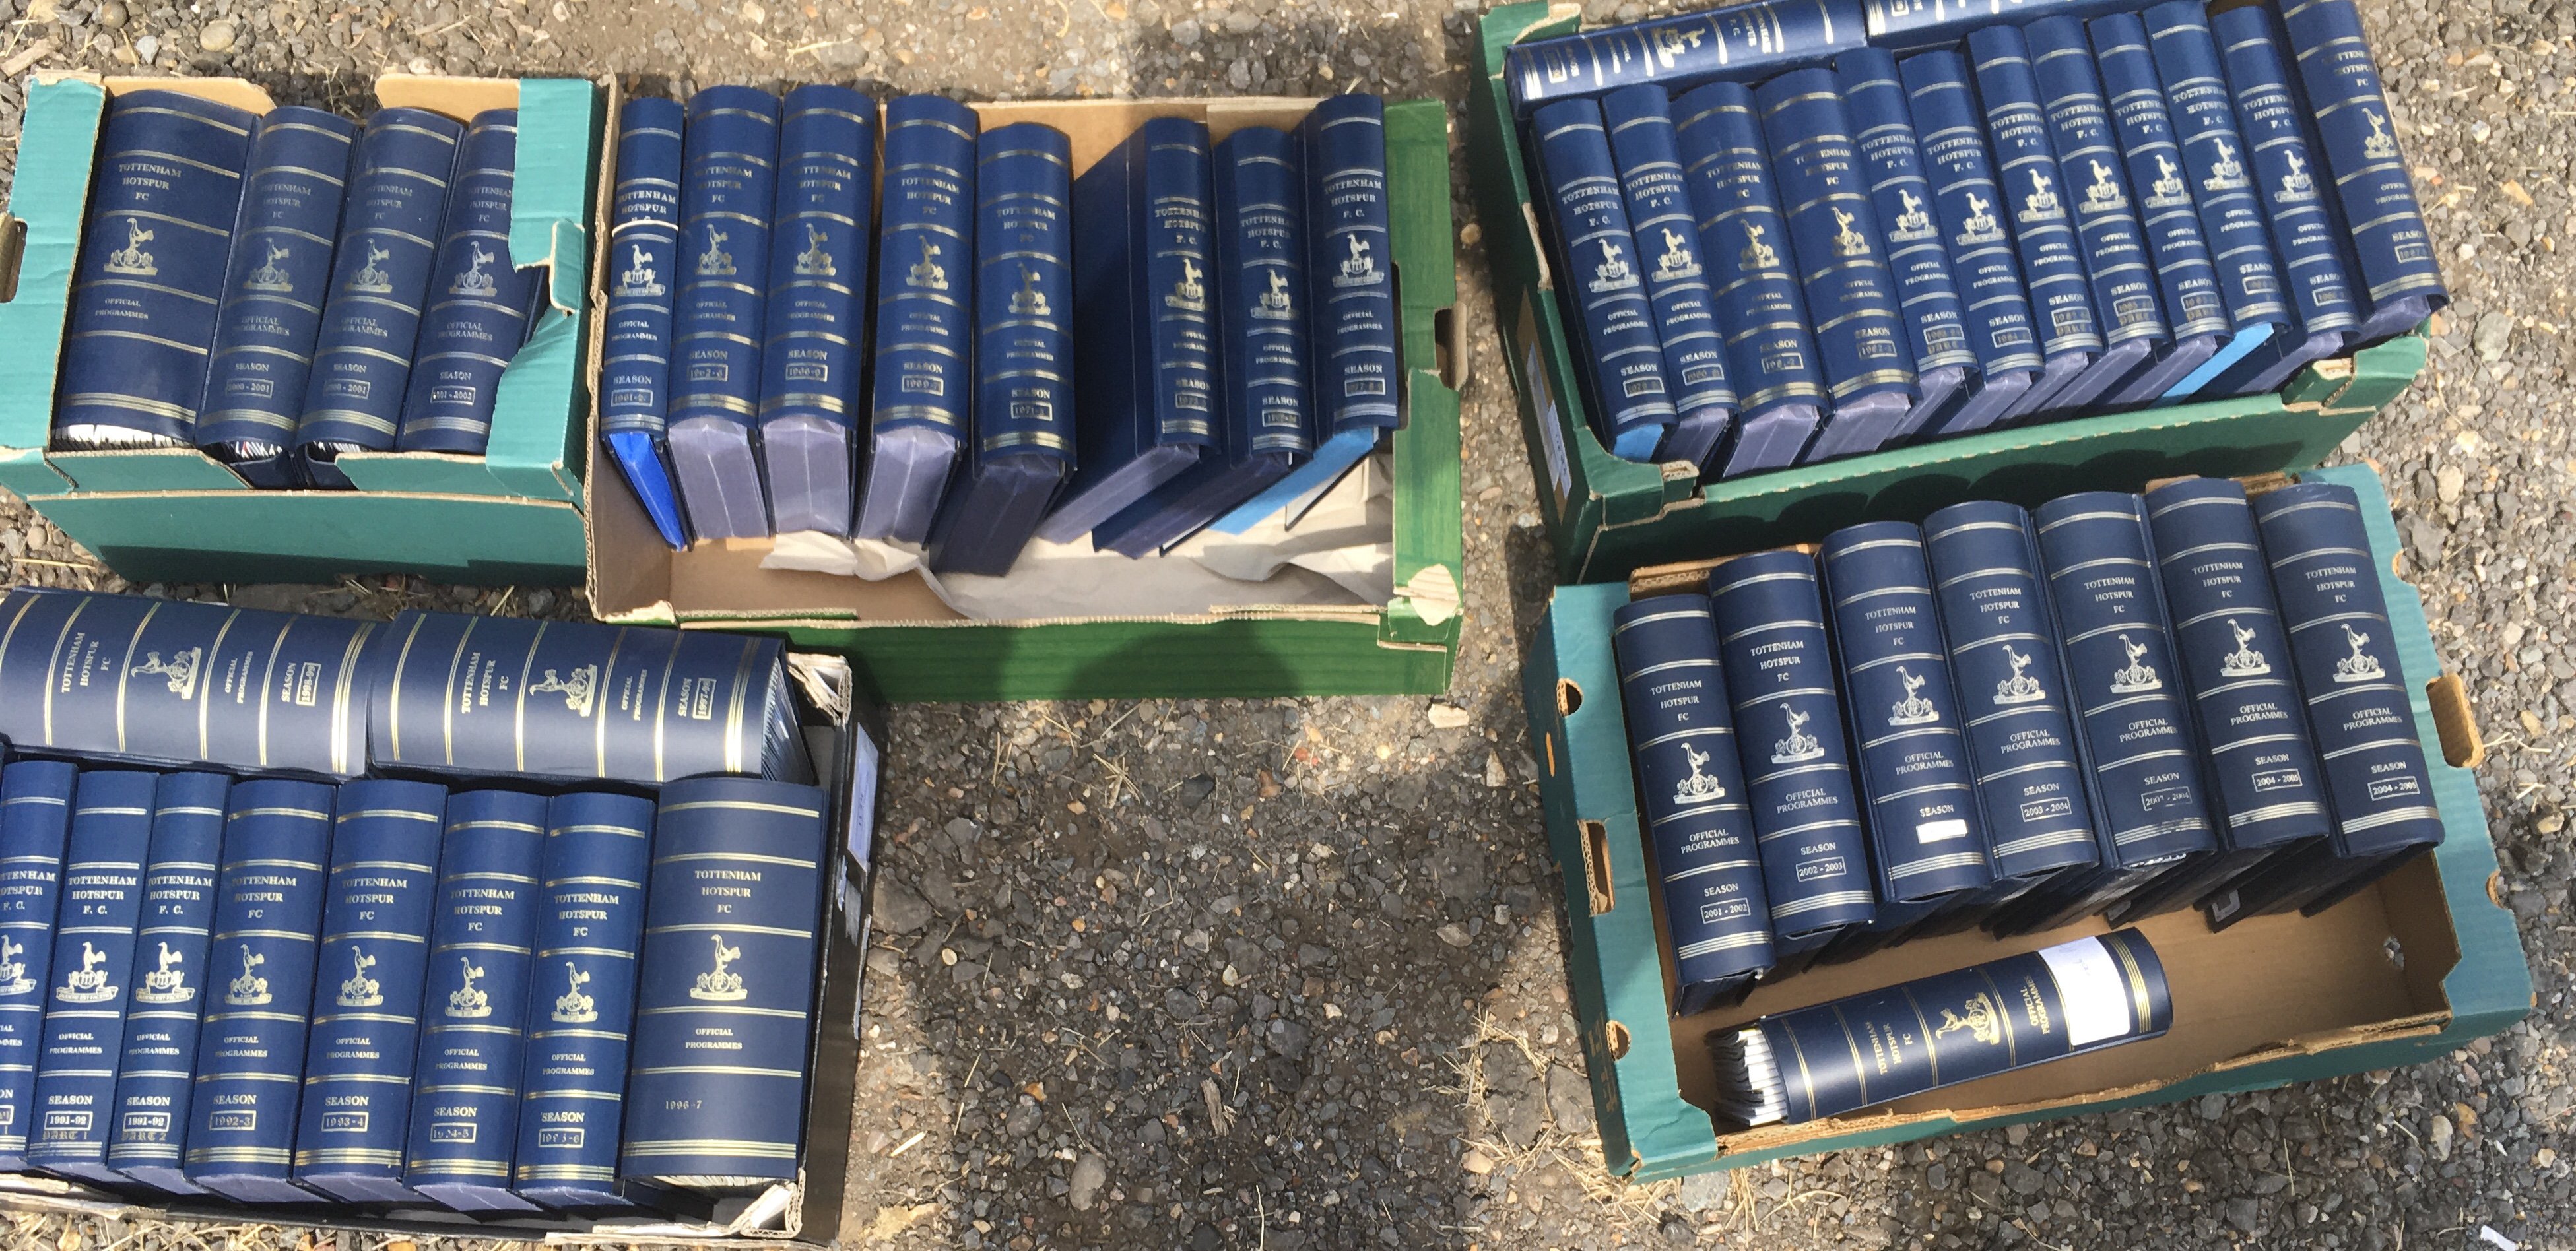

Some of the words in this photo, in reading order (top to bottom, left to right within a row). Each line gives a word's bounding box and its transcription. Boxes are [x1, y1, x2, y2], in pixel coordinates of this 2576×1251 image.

[119, 162, 182, 177] TOTTENHAM
[123, 177, 170, 190] HOTSPUR
[135, 191, 149, 201] FC
[1634, 184, 1680, 199] HOTSPUR
[105, 298, 140, 307] OFFICIAL
[1670, 302, 1702, 312] OFFICIAL
[94, 309, 149, 320] PROGRAMMES
[2192, 561, 2243, 575] TOTTENHAM
[2305, 567, 2357, 580] TOTTENHAM
[2084, 577, 2135, 591] TOTTENHAM
[2203, 576, 2241, 587] HOTSPUR
[2316, 580, 2355, 591] HOTSPUR
[1970, 587, 2021, 601] TOTTENHAM
[2095, 591, 2134, 602] HOTSPUR
[1980, 600, 2020, 612] HOTSPUR
[2113, 605, 2125, 614] FC
[1865, 606, 1917, 620] TOTTENHAM
[1998, 616, 2009, 624] FC
[1875, 620, 1915, 633] HOTSPUR
[1750, 641, 1804, 655] TOTTENHAM
[61, 631, 84, 693] TOTTENHAM
[79, 641, 98, 686] HOTSPUR
[100, 658, 110, 671] FC
[1760, 657, 1801, 669] HOTSPUR
[224, 658, 238, 693] OFFICIAL
[236, 651, 253, 703] PROGRAMMES
[281, 662, 296, 702] SEASON
[300, 665, 316, 703] 1998-99
[461, 653, 481, 713] TOTTENHAM
[479, 660, 496, 706] HOTSPUR
[500, 677, 509, 690] FC
[1651, 680, 1702, 695] TOTTENHAM
[621, 676, 634, 710] OFFICIAL
[633, 669, 647, 720] PROGRAMMES
[678, 679, 692, 717] SEASON
[1661, 695, 1700, 709] HOTSPUR
[2239, 703, 2278, 715] OFFICIAL
[2352, 707, 2393, 720] OFFICIAL
[1678, 713, 1690, 721] FC
[2230, 710, 2288, 726] PROGRAMMES
[2343, 715, 2402, 731] PROGRAMMES
[2128, 719, 2168, 731] OFFICIAL
[2010, 730, 2050, 742] OFFICIAL
[2001, 738, 2061, 753] PROGRAMMES
[1905, 751, 1944, 764] OFFICIAL
[2255, 754, 2289, 765] SEASON
[1896, 758, 1954, 775] PROGRAMMES
[2371, 761, 2406, 773] SEASON
[2144, 773, 2179, 785] SEASON
[2256, 777, 2275, 788] 2004
[2282, 774, 2299, 785] 2005
[2024, 783, 2060, 794] SEASON
[2372, 784, 2392, 794] 2004
[2399, 781, 2416, 791] 2005
[1785, 788, 1827, 802] OFFICIAL
[1777, 795, 1837, 813] PROGRAMMES
[2024, 806, 2043, 817] 2003
[2051, 802, 2068, 812] 2004
[1920, 804, 1954, 818] SEASON
[1689, 829, 1729, 842] OFFICIAL
[1680, 835, 1740, 853] PROGRAMMES
[1800, 842, 1836, 855] SEASON
[1799, 864, 1818, 876] 2002
[1826, 860, 1843, 872] 2003
[68, 876, 137, 886] TOTTENHAM
[694, 870, 761, 881] TOTTENHAM
[148, 878, 212, 887] TOTTENHAM
[72, 891, 124, 900] HOTSPUR
[701, 887, 751, 897] HOTSPUR
[1704, 883, 1738, 896] SEASON
[149, 891, 200, 901] HOTSPUR
[554, 893, 620, 905] TOTTENHAM
[98, 906, 108, 914] C.
[248, 909, 263, 918] FC
[454, 906, 502, 915] HOTSPUR
[717, 905, 731, 913] FC
[1704, 906, 1723, 918] 2001
[1731, 901, 1748, 914] 2002
[359, 911, 374, 920] FC
[559, 911, 607, 920] HOTSPUR
[469, 922, 482, 931] FC
[573, 927, 588, 936] FC
[2020, 987, 2038, 1027] OFFICIAL
[2023, 975, 2050, 1035] PROGRAMMES
[137, 1033, 170, 1042] OFFICIAL
[335, 1037, 371, 1046] OFFICIAL
[1882, 1022, 1902, 1064] HOTSPUR
[1903, 1033, 1913, 1045] FC
[49, 1046, 102, 1055] PROGRAMMES
[685, 1041, 743, 1050] PROGRAMMES
[1865, 1021, 1888, 1075] TOTTENHAM
[48, 1095, 93, 1105] SEASON
[126, 1096, 170, 1107] SEASON
[213, 1095, 256, 1105] SEASON
[325, 1096, 368, 1107] SEASON
[433, 1107, 477, 1116] SEASON
[541, 1112, 585, 1122] SEASON
[49, 1115, 88, 1125] 1991-92
[127, 1116, 165, 1126] 1991-92
[214, 1115, 251, 1126] 1992-3
